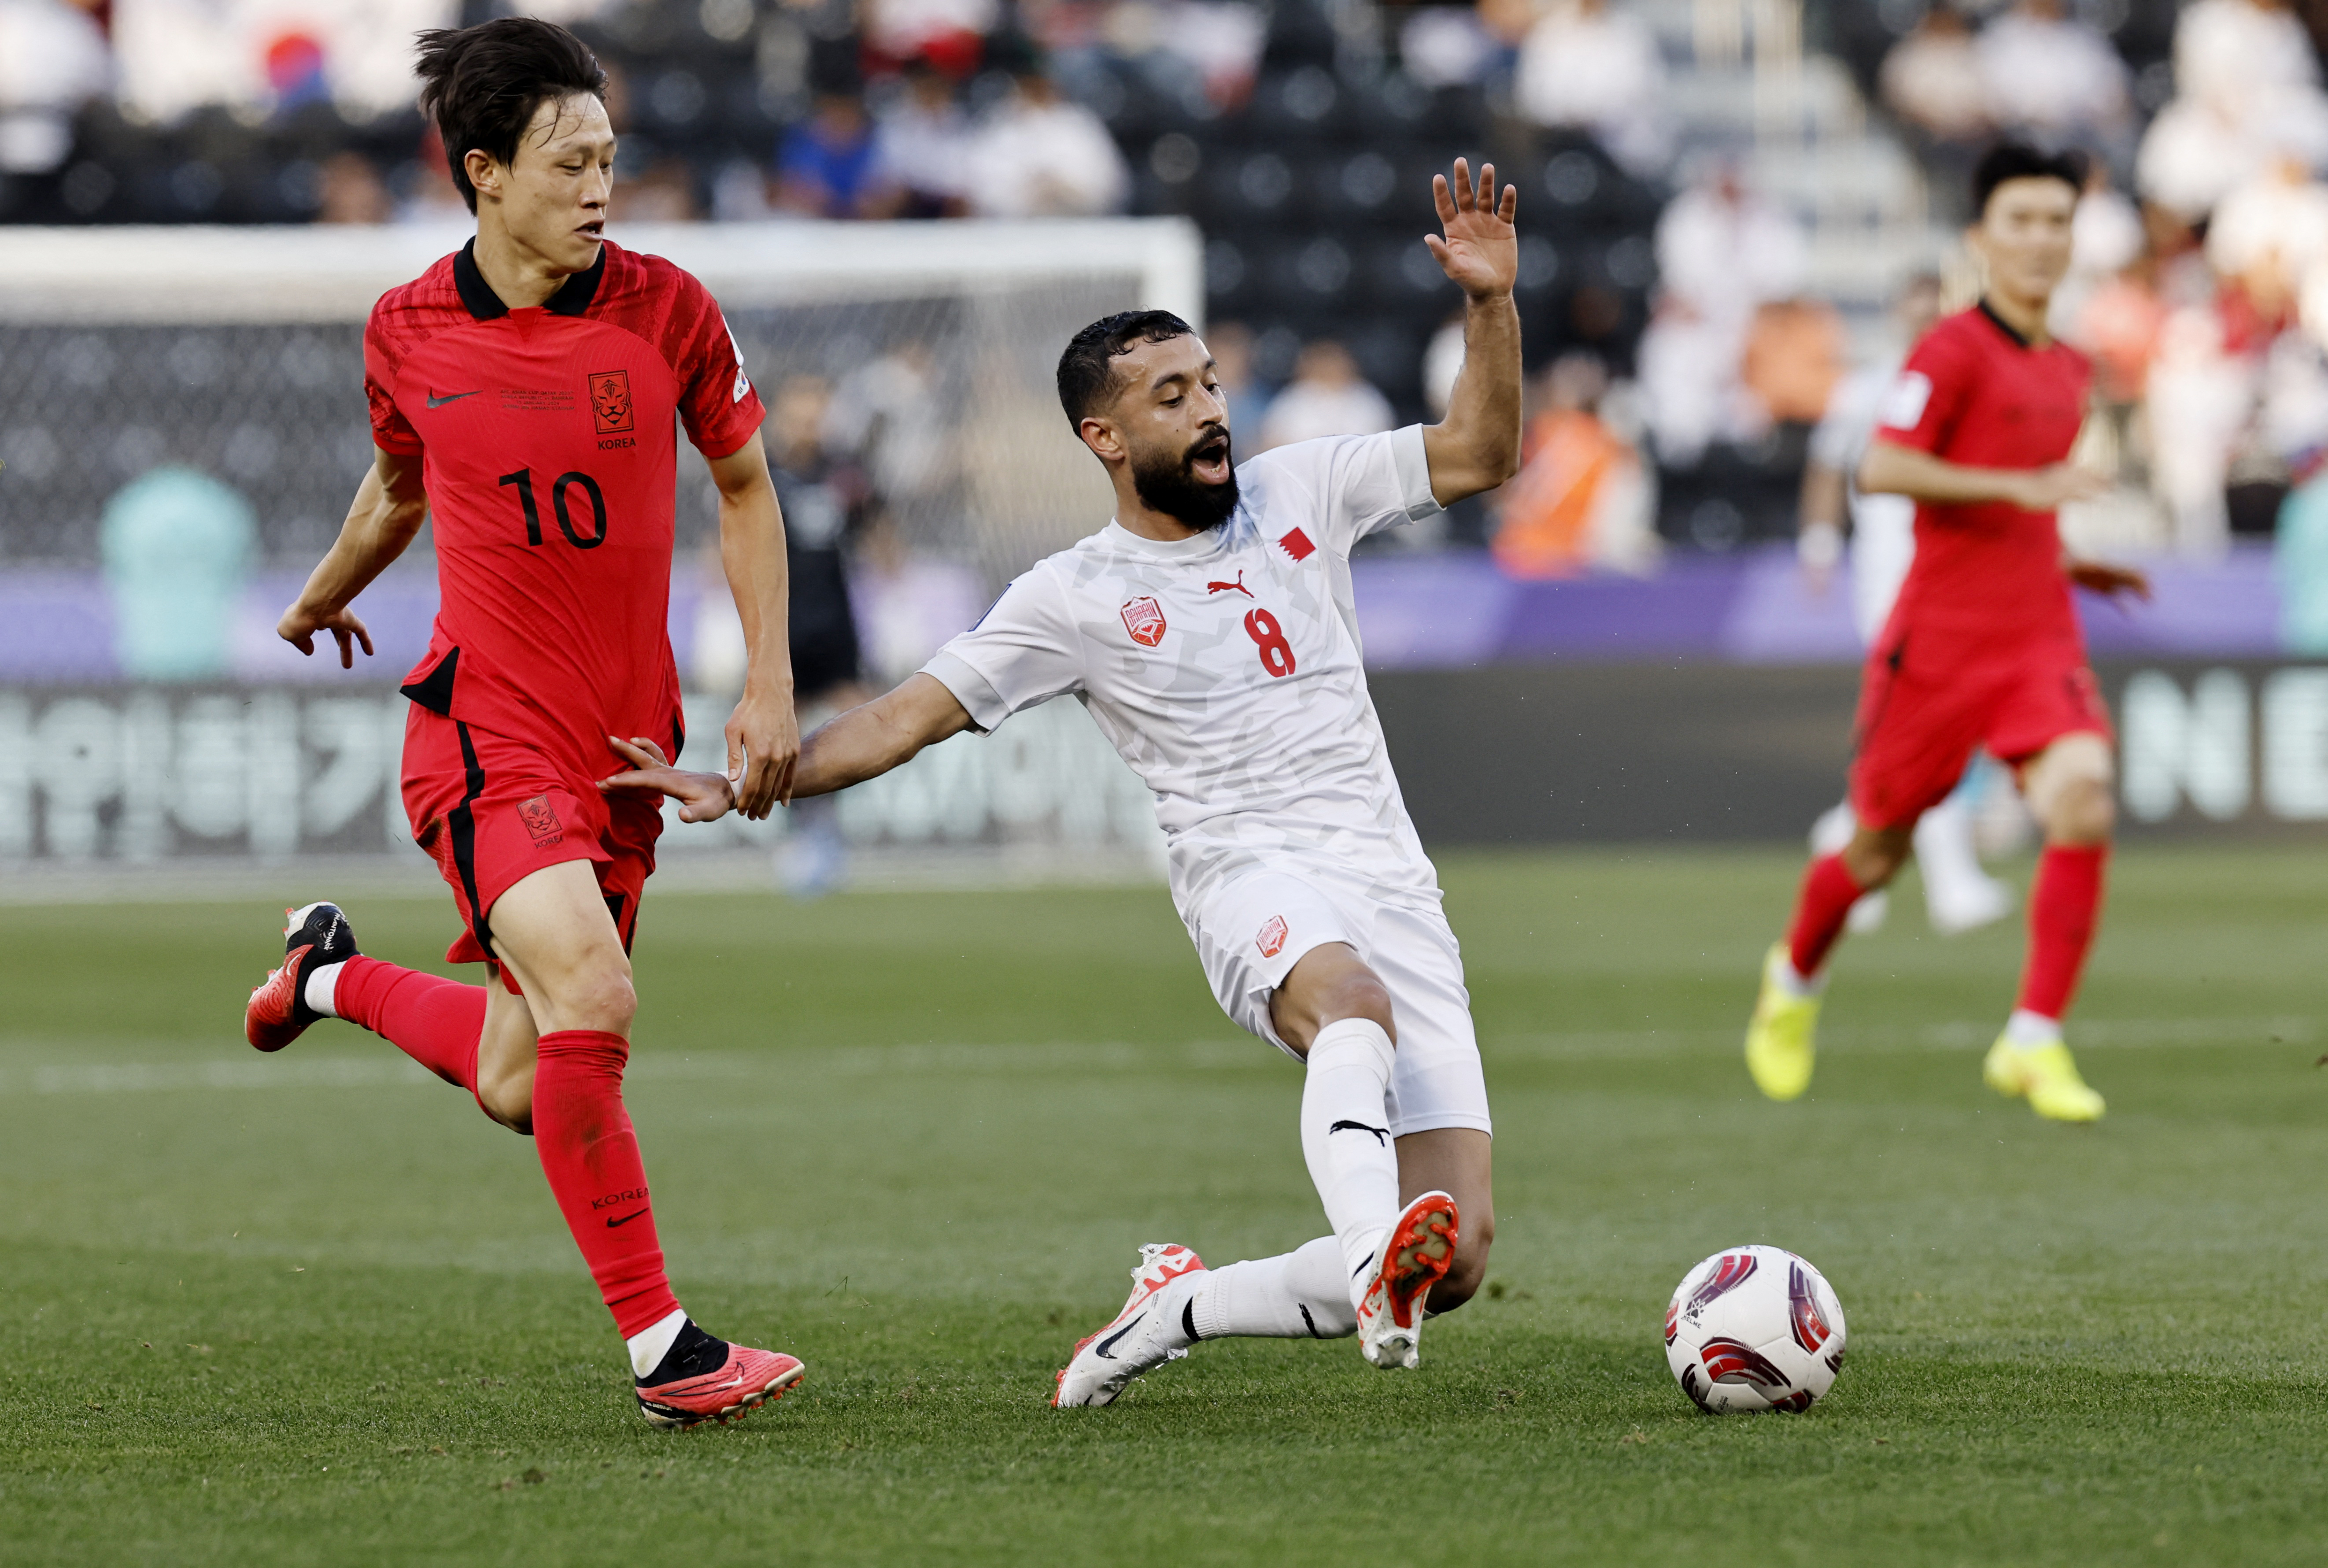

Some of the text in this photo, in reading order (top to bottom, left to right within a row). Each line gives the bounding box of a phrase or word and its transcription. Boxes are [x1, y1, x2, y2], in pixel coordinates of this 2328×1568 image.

[598, 437, 636, 451] KOREA
[499, 468, 607, 549] 10
[1244, 608, 1296, 677] 8
[591, 1187, 650, 1210] KOREA
[1681, 1314, 1702, 1329] KELME
